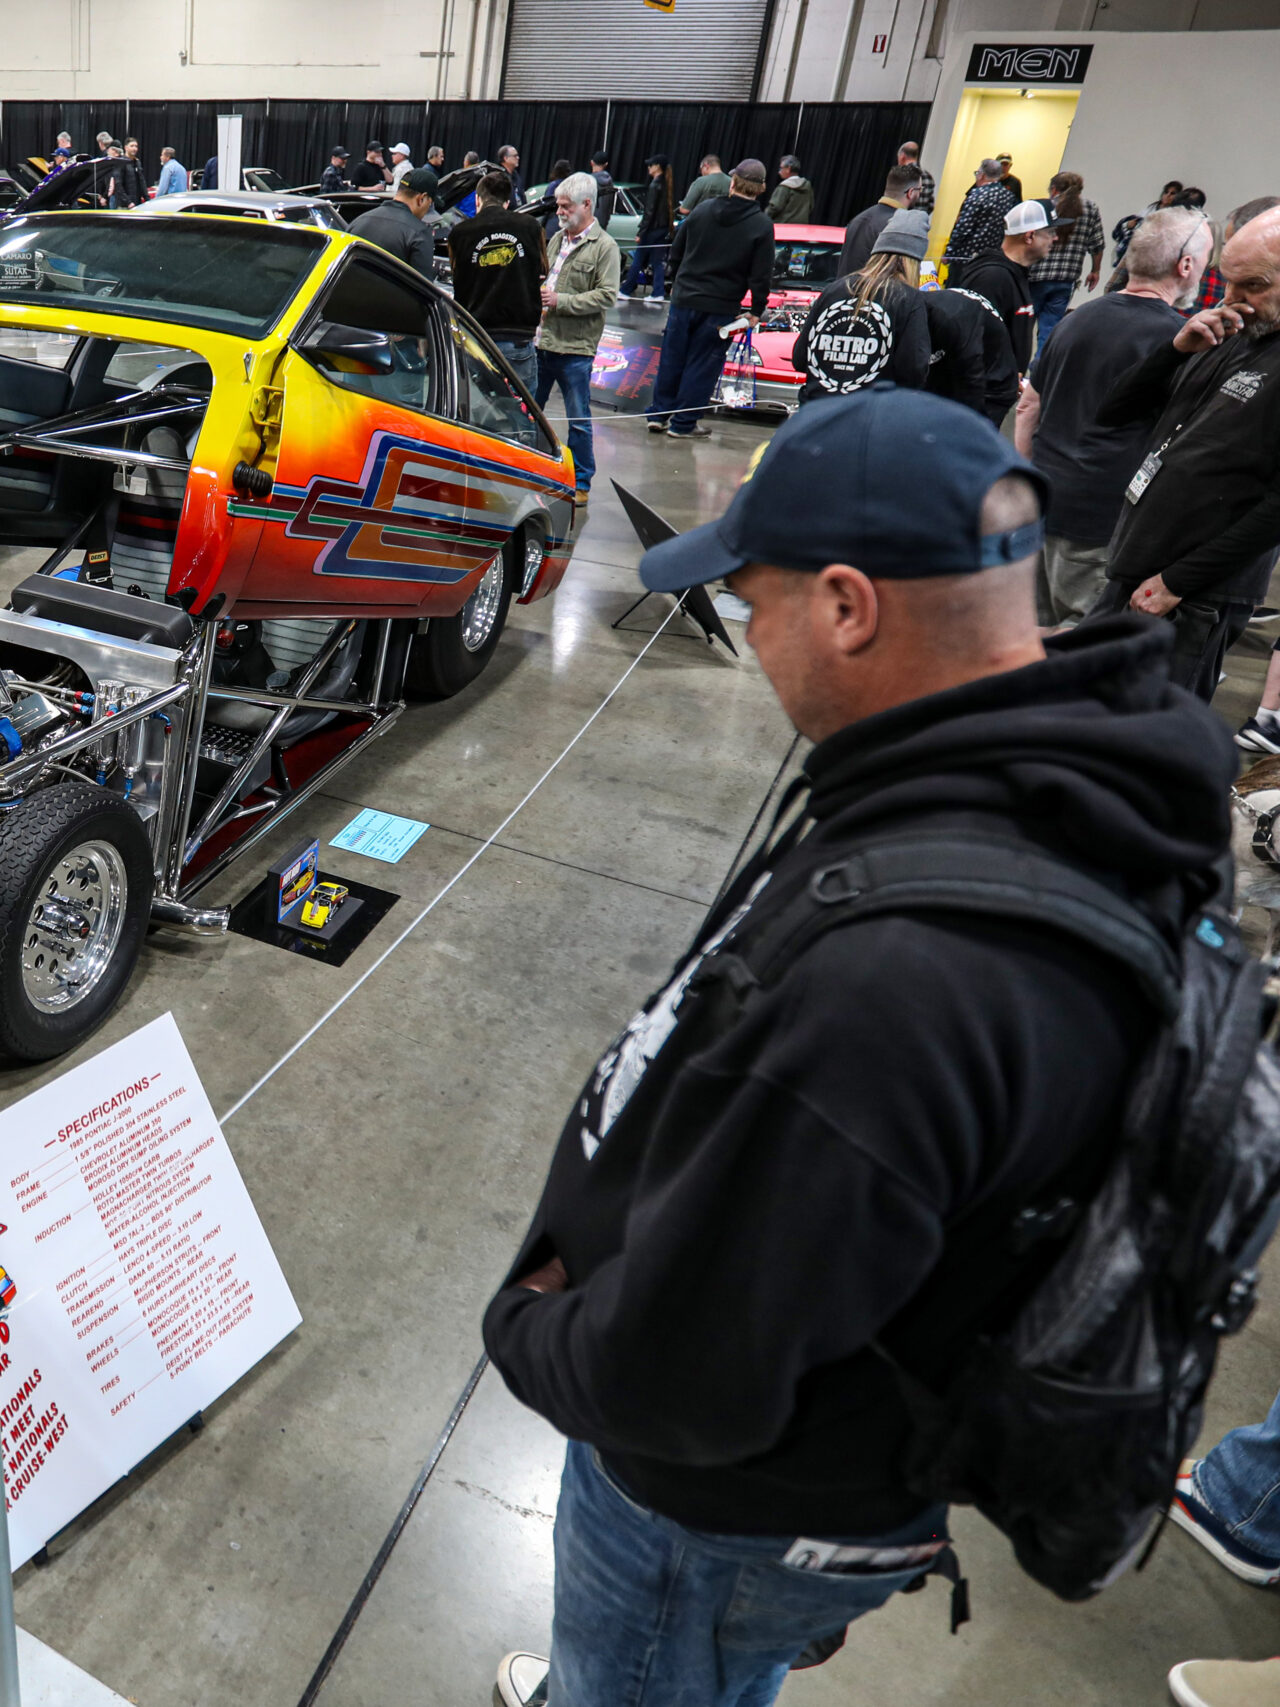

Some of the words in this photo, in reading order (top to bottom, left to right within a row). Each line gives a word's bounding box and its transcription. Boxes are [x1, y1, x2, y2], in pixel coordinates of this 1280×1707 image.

[978, 48, 1081, 78] MEN
[490, 232, 518, 244] ROADSTER
[818, 334, 879, 355] RETRO
[823, 350, 848, 363] FILM
[849, 353, 869, 365] LAB
[15, 1180, 40, 1200] FRAME
[92, 1126, 125, 1150] POLISHED
[124, 1119, 136, 1129] 304
[136, 1097, 167, 1122] STAINLESS
[167, 1087, 186, 1101] STEEL
[56, 1076, 150, 1143] SPECIFICATIONS
[10, 1171, 30, 1188] BODY
[68, 1136, 84, 1149] 1985
[83, 1118, 112, 1139] PONTIAC
[113, 1106, 132, 1122] J-2000
[20, 1191, 48, 1213] ENGINE
[79, 1144, 118, 1174] CHEVROLET
[118, 1123, 151, 1148] ALUMINUM
[150, 1116, 162, 1126] 350
[83, 1163, 108, 1183] BRODIX
[109, 1140, 142, 1167] ALUMINUM
[141, 1126, 163, 1143] HEADS
[87, 1168, 116, 1192] MOROSO
[116, 1160, 128, 1172] DRY
[129, 1146, 148, 1162] SUMP
[148, 1133, 168, 1150] OILING
[169, 1117, 192, 1136] SYSTEM
[96, 1177, 141, 1212] ROTO-MASTER
[140, 1167, 157, 1178] TWIN
[157, 1148, 182, 1168] TURBOS
[145, 1178, 171, 1200] NITROUS
[171, 1161, 195, 1181] SYSTEM
[34, 1215, 72, 1243] INDUCTION
[92, 1183, 117, 1203] HOLLEY
[143, 1152, 160, 1168] CARB
[55, 1266, 86, 1291] IGNITION
[113, 1236, 128, 1250] MSD
[174, 1175, 212, 1206] DISTRIBUTOR
[100, 1180, 152, 1221] MAGNACHARGER
[107, 1199, 160, 1238] WATER-ALCOHOL
[160, 1175, 191, 1200] INJECTION
[60, 1280, 88, 1304] CLUTCH
[118, 1245, 135, 1261] HAYS
[135, 1229, 157, 1246] TRIPLE
[157, 1219, 172, 1232] DISC
[65, 1276, 116, 1314] TRANSMISSION
[123, 1253, 144, 1273] LENCO
[145, 1234, 172, 1256] 4-SPEED
[188, 1209, 202, 1224] LOW
[71, 1299, 104, 1327] REAREND
[127, 1268, 146, 1286] DANA
[172, 1234, 190, 1250] RATIO
[76, 1304, 119, 1339] SUSPENSION
[173, 1244, 197, 1264] STRUTS
[201, 1223, 222, 1243] FRONT
[136, 1288, 155, 1304] RIGID
[155, 1268, 181, 1291] MOUNTS
[186, 1249, 203, 1266] REAR
[85, 1335, 114, 1360] BRAKES
[199, 1255, 216, 1273] DISCS
[90, 1347, 119, 1372] WHEELS
[146, 1293, 187, 1328] MONOCOQUE
[188, 1287, 194, 1295] 15
[218, 1252, 237, 1270] FRONT
[100, 1375, 120, 1393] TIRES
[156, 1319, 189, 1349] PNEUMANT
[219, 1278, 238, 1296] FRONT
[151, 1303, 190, 1337] MONOCOQUE
[216, 1268, 232, 1284] REAR
[194, 1339, 213, 1359] BELTS
[218, 1305, 251, 1336] PARACHUTE
[109, 1392, 135, 1416] SAFETY
[165, 1351, 182, 1371] DEIST
[183, 1323, 217, 1352] FLAME-OUT
[217, 1311, 231, 1325] FIRE
[231, 1293, 254, 1315] SYSTEM
[159, 1327, 193, 1357] FIRESTONE
[0, 1368, 42, 1428] ATIONALS
[8, 1404, 35, 1443] MEET
[7, 1401, 58, 1474] NATIONALS
[9, 1413, 68, 1501] CRUISE-WEST
